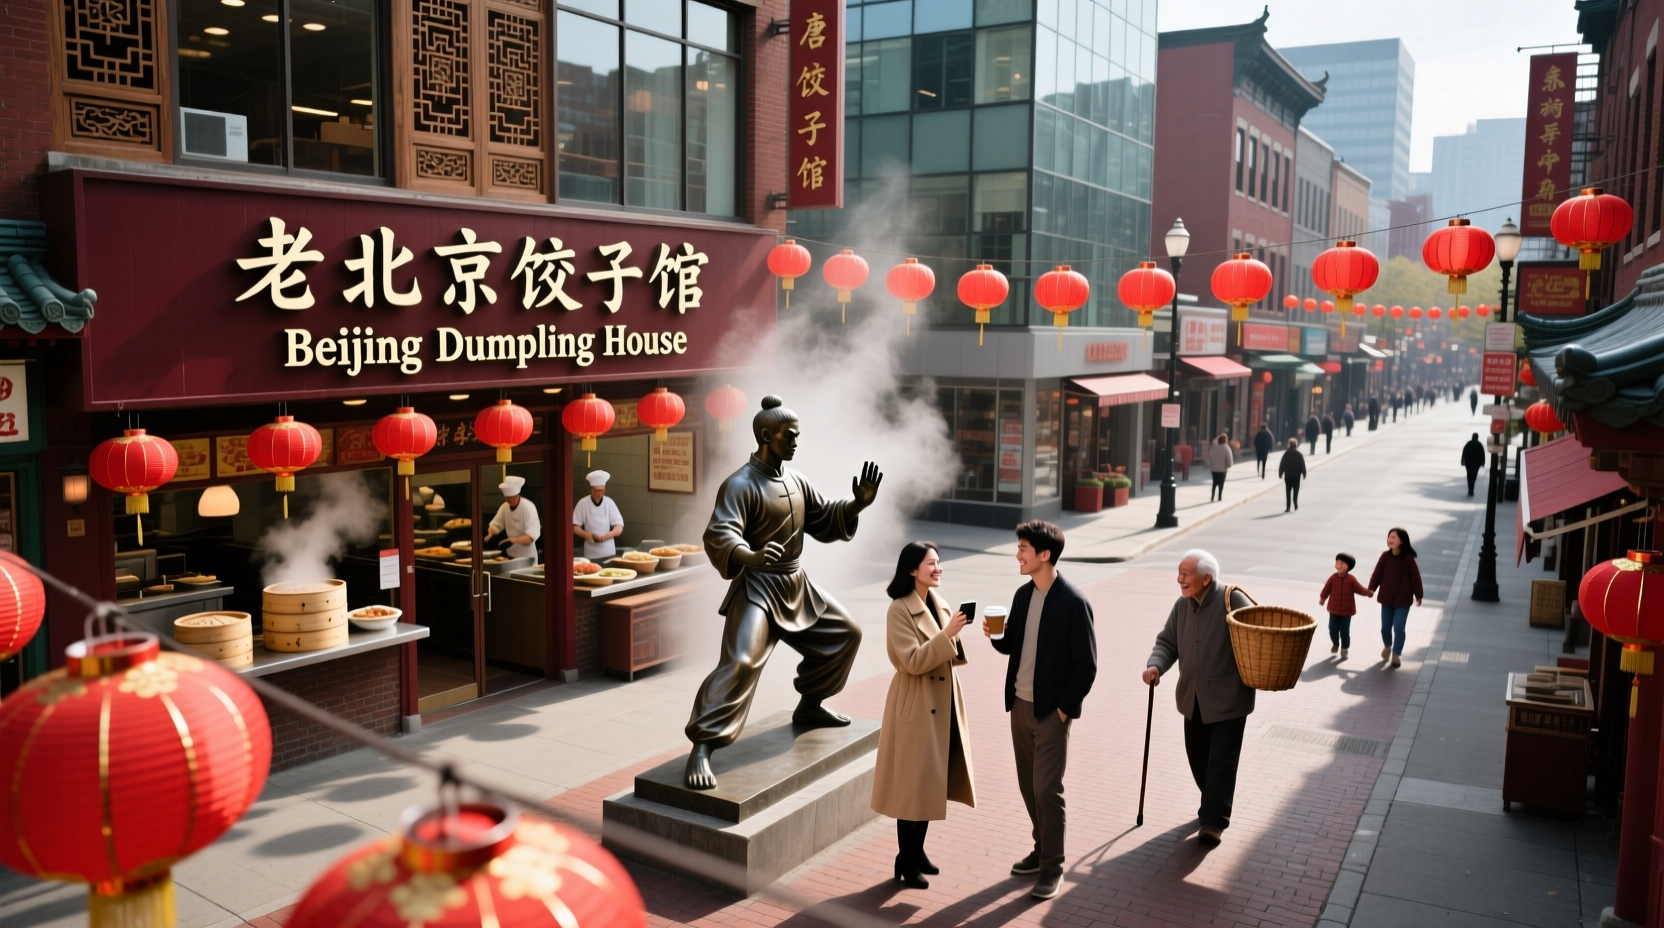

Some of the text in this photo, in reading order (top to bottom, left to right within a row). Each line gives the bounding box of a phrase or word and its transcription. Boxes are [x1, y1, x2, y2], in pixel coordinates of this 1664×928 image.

[796, 12, 829, 190] 唐饺子馆
[235, 216, 709, 315] 老北京饺子馆
[284, 325, 688, 376] Beijing Dumpling House
